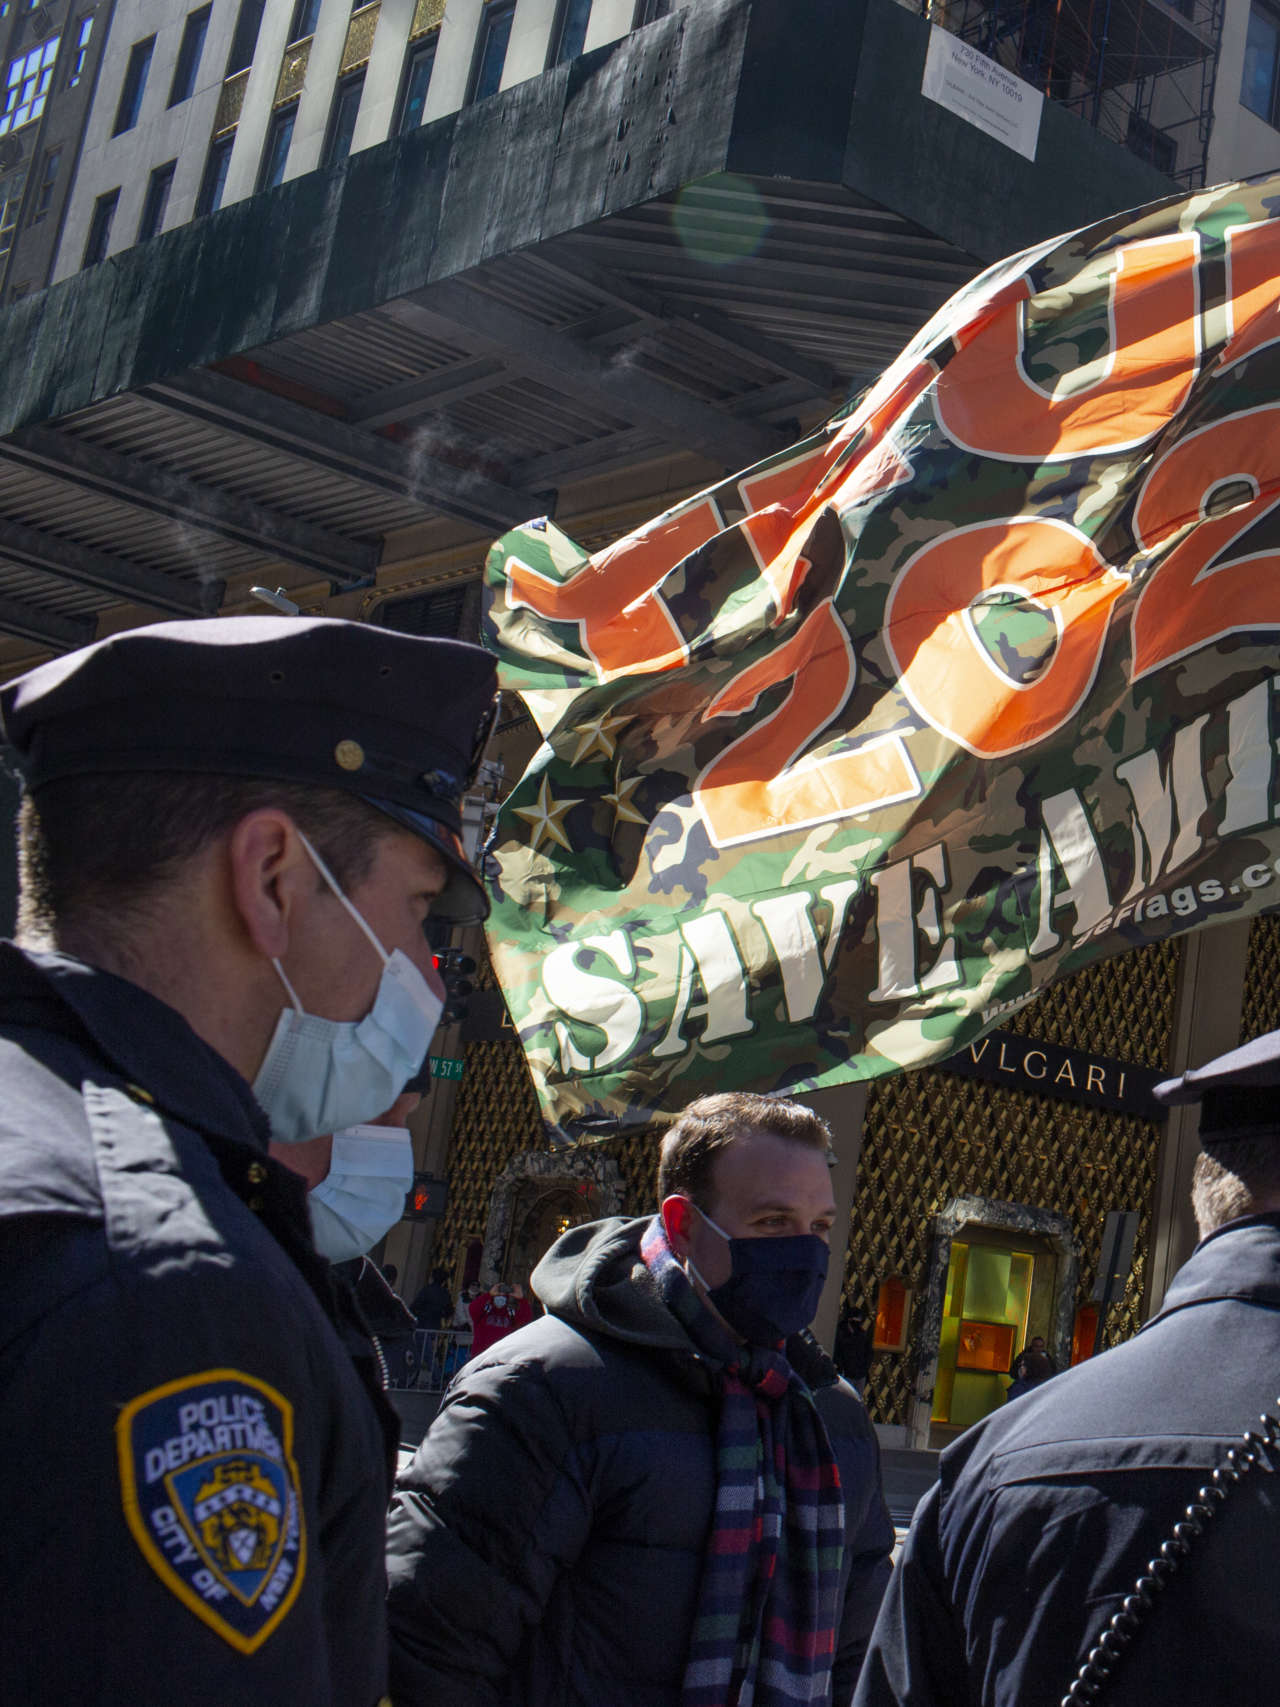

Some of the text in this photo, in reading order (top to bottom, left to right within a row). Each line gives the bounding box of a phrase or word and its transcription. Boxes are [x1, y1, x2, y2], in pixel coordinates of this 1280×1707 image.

[540, 842, 964, 1077] SAVE
[440, 1060, 453, 1076] 57
[970, 1039, 1127, 1099] VLGARI
[151, 1505, 200, 1565] CITY
[192, 1568, 229, 1601] OF
